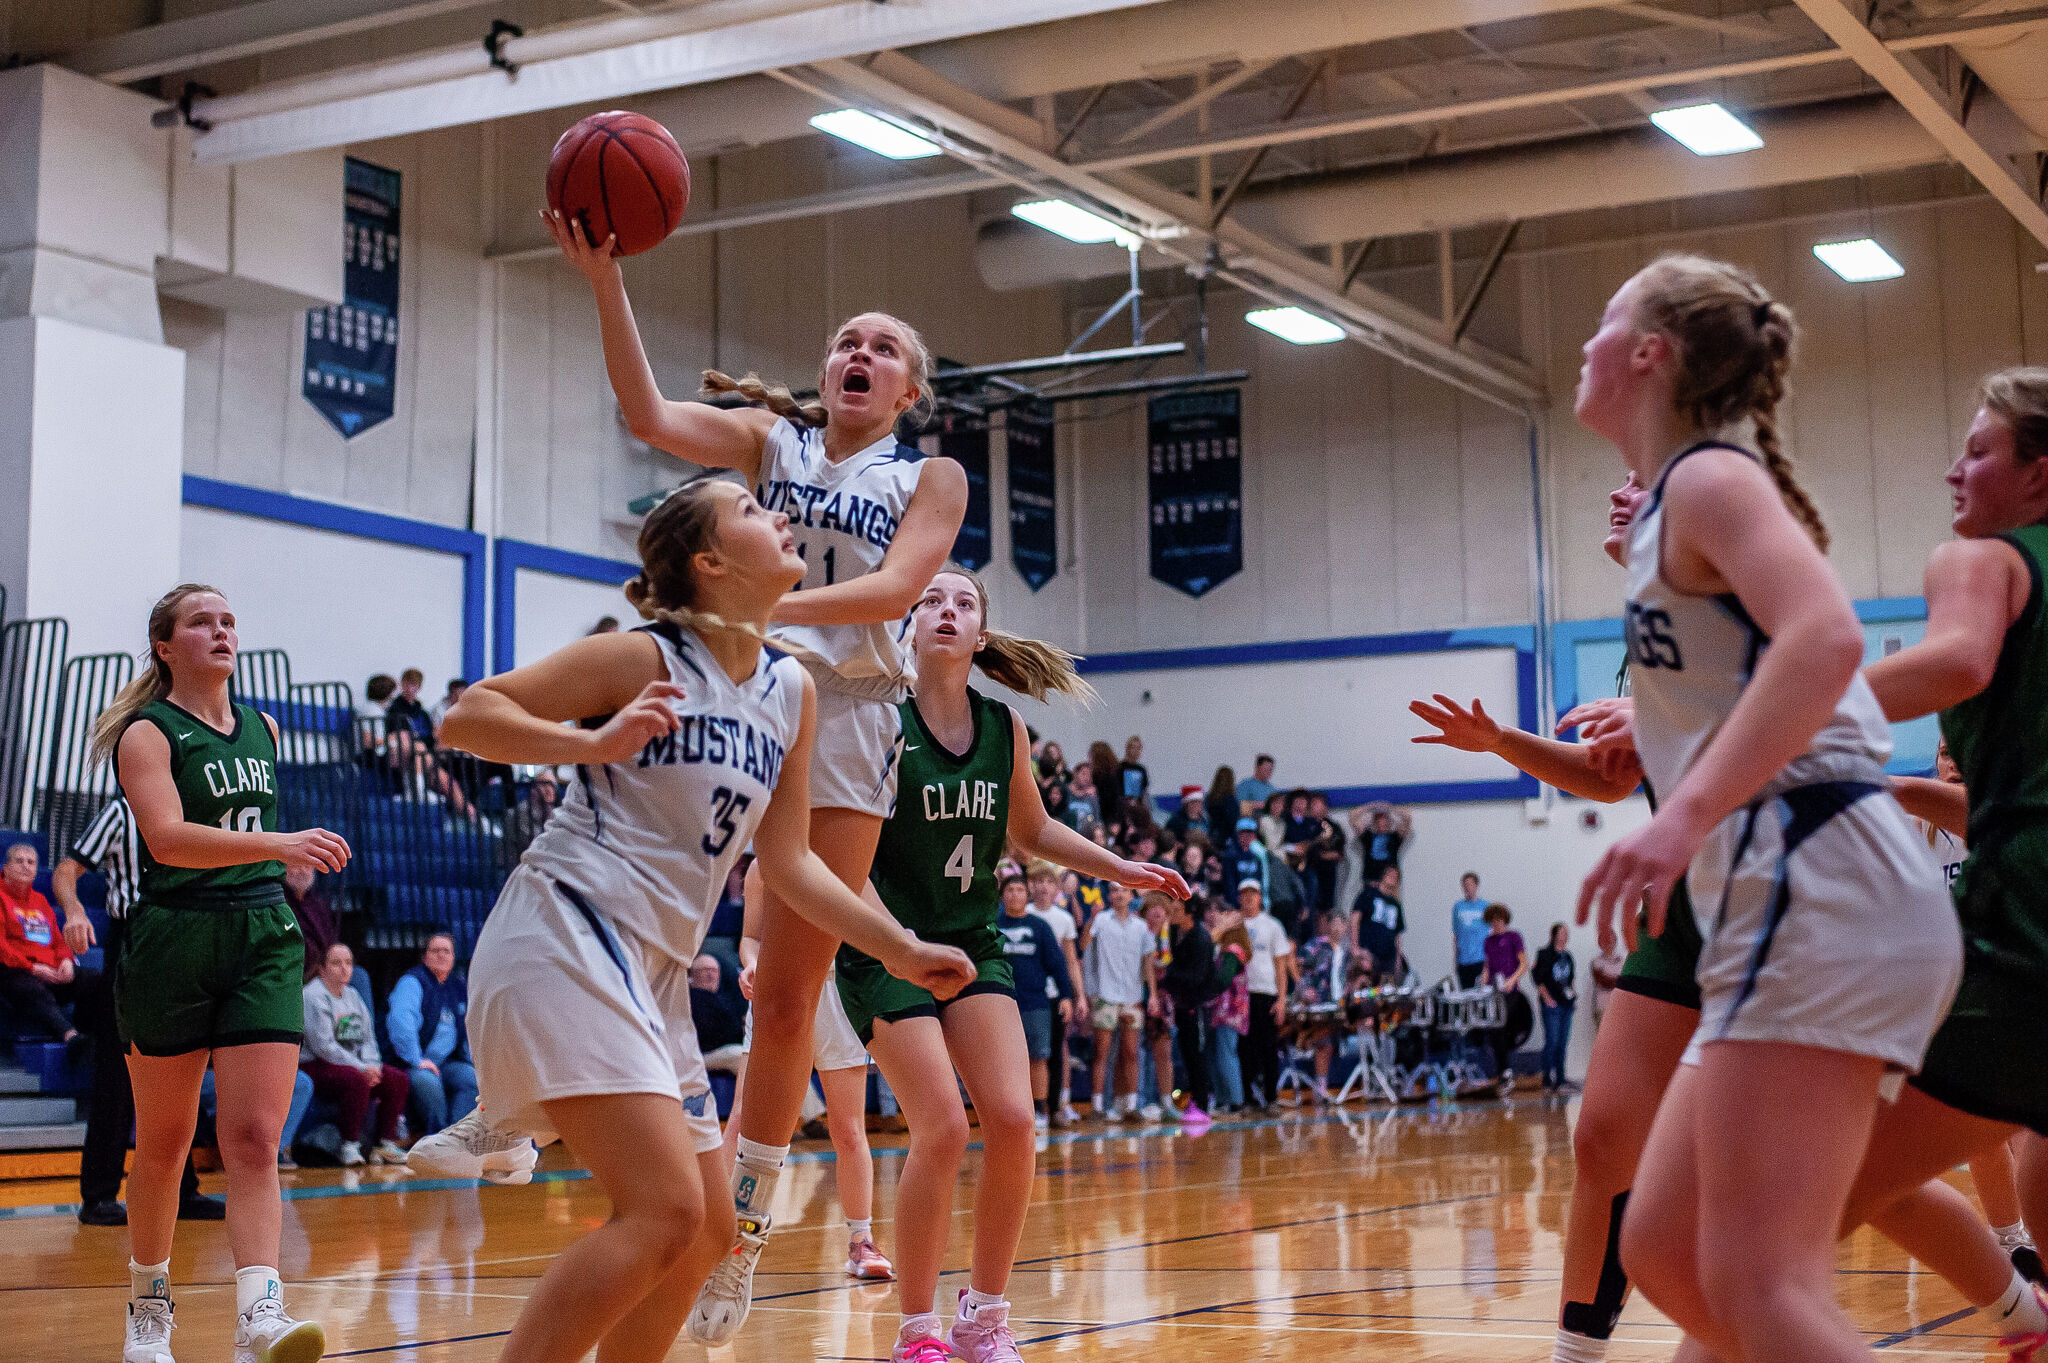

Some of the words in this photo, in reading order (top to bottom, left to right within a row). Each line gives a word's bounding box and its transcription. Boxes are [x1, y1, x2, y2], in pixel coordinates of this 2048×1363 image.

[203, 757, 273, 797] CLARE
[922, 780, 998, 821] CLARE
[701, 785, 751, 857] 35
[944, 834, 975, 894] 4
